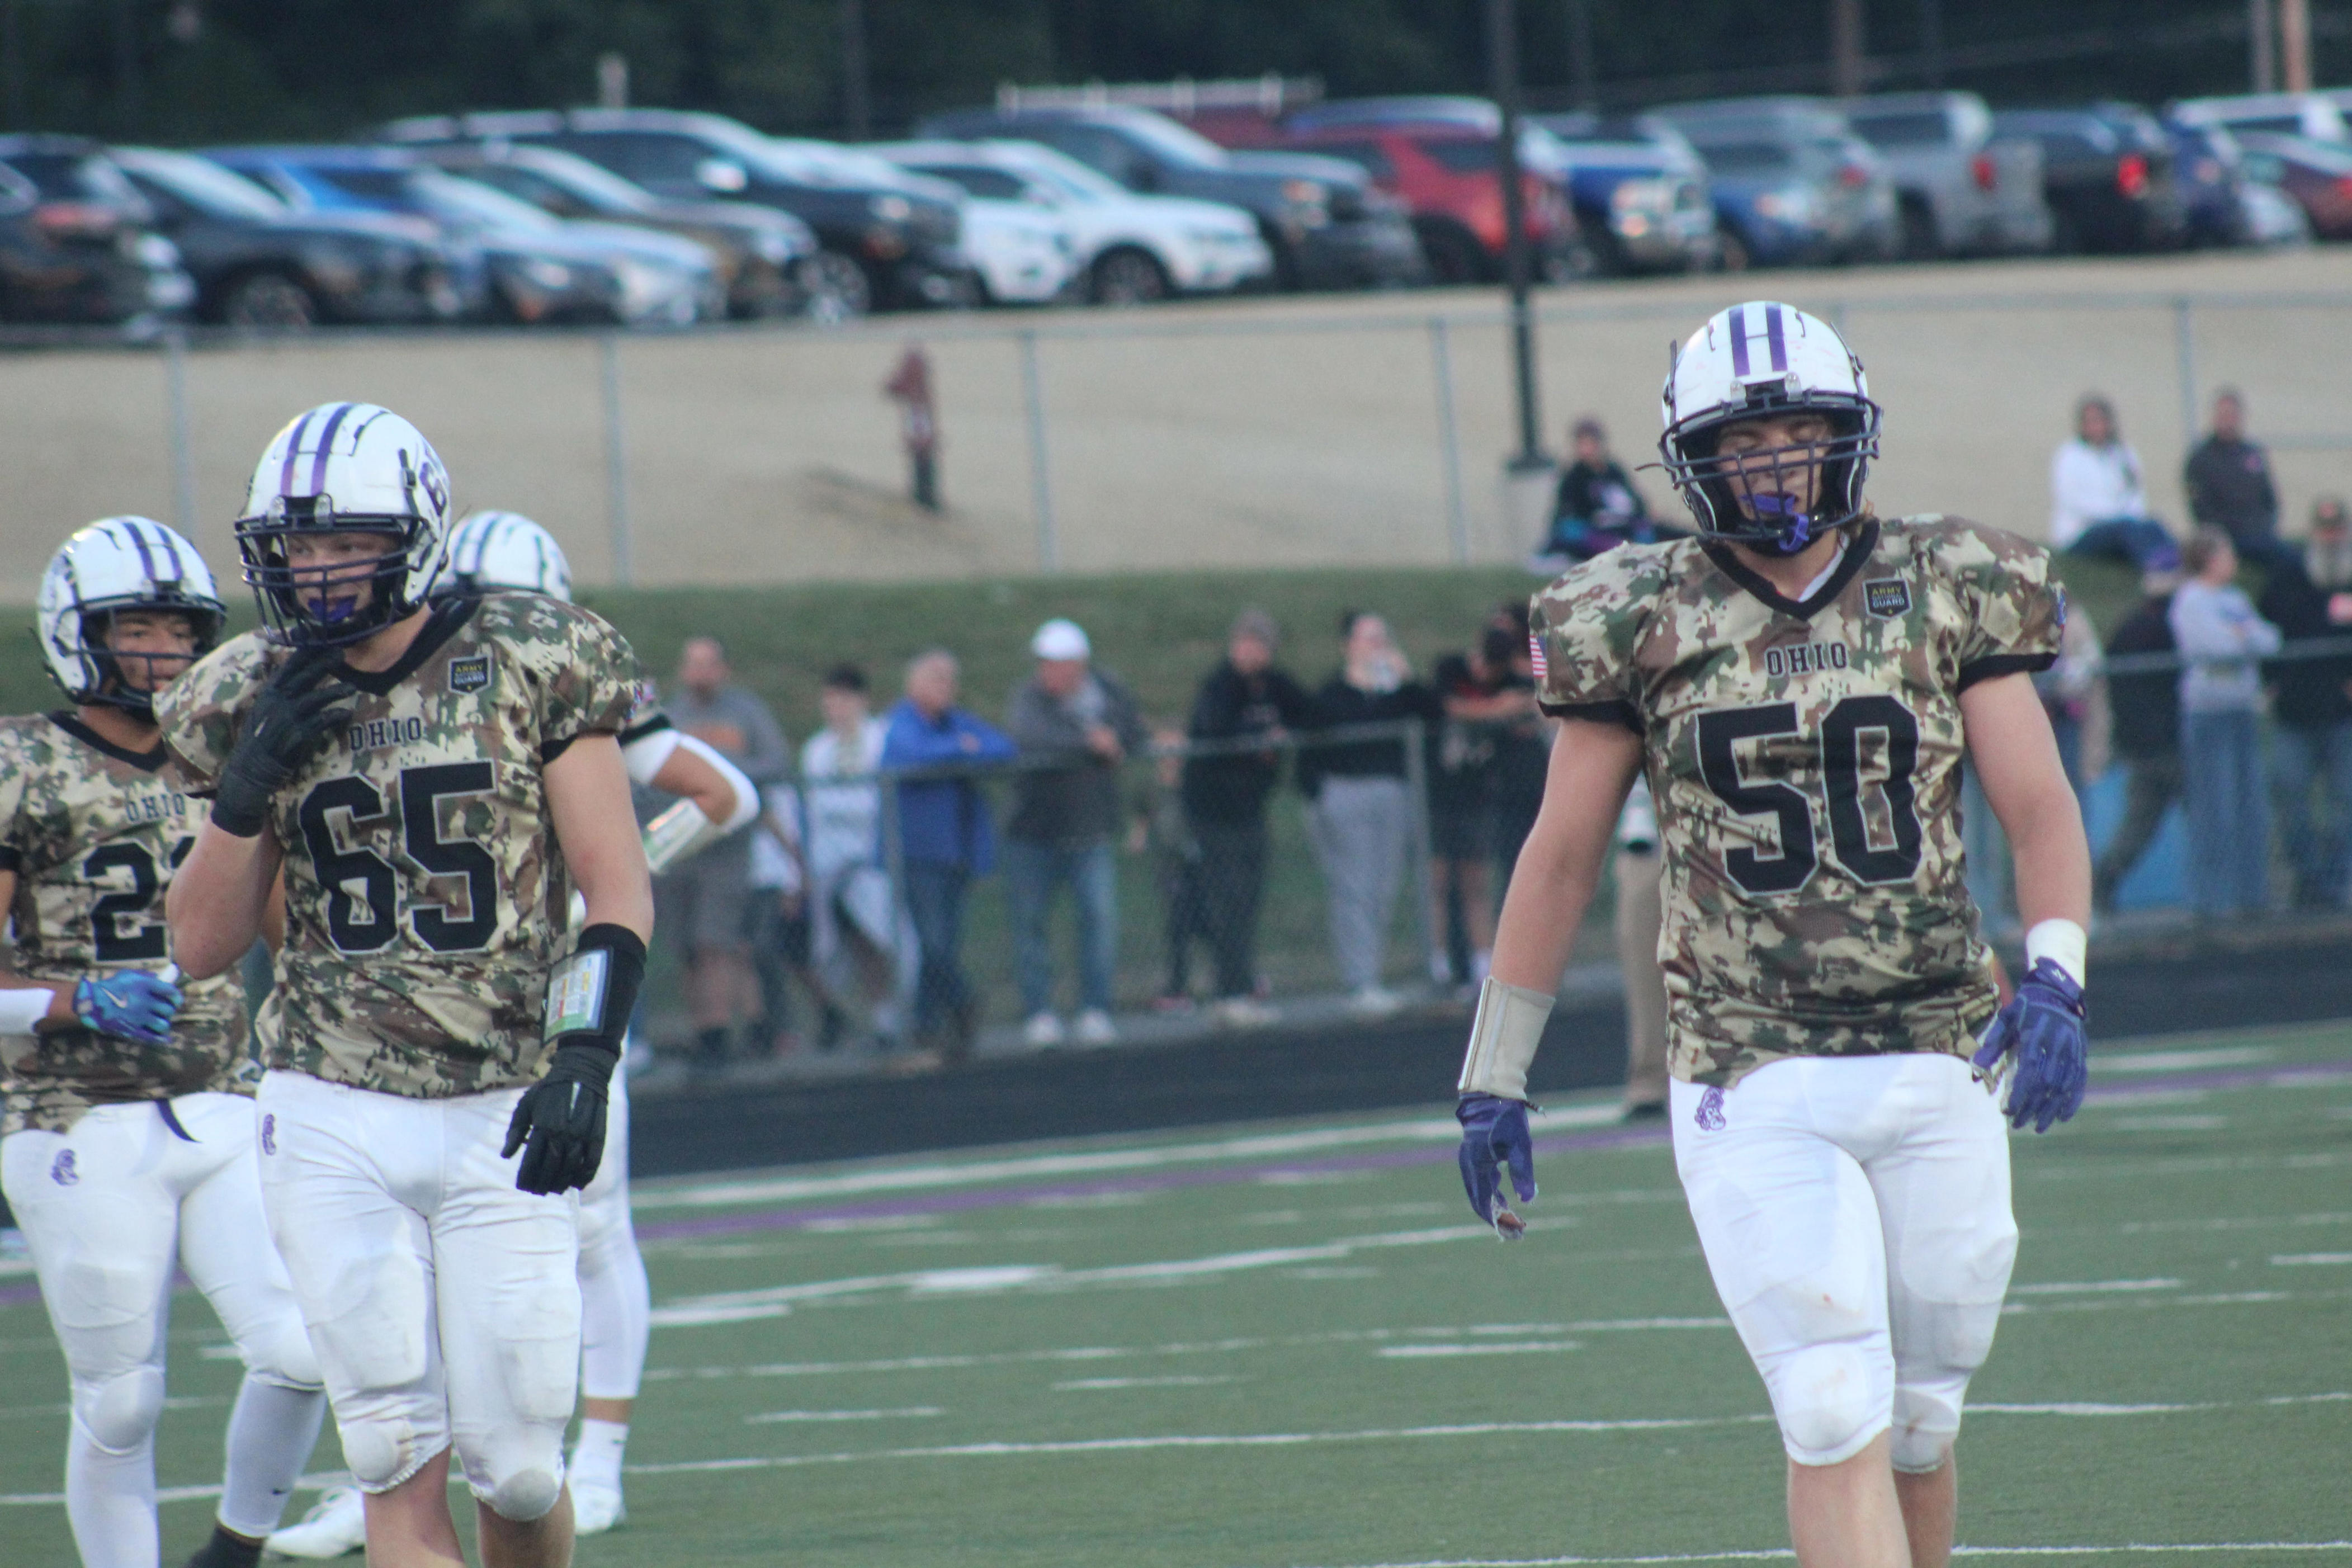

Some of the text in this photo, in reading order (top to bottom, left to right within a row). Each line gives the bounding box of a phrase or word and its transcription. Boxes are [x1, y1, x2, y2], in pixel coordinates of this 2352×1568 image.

[1872, 586, 1901, 595] ARMY
[1873, 598, 1905, 608] GUARD
[1766, 642, 1848, 677] OHIO
[350, 716, 422, 751] OHIO
[126, 793, 186, 823] OHIO
[1695, 695, 1922, 896] 50
[299, 758, 498, 953] 65
[84, 835, 196, 962] 2
